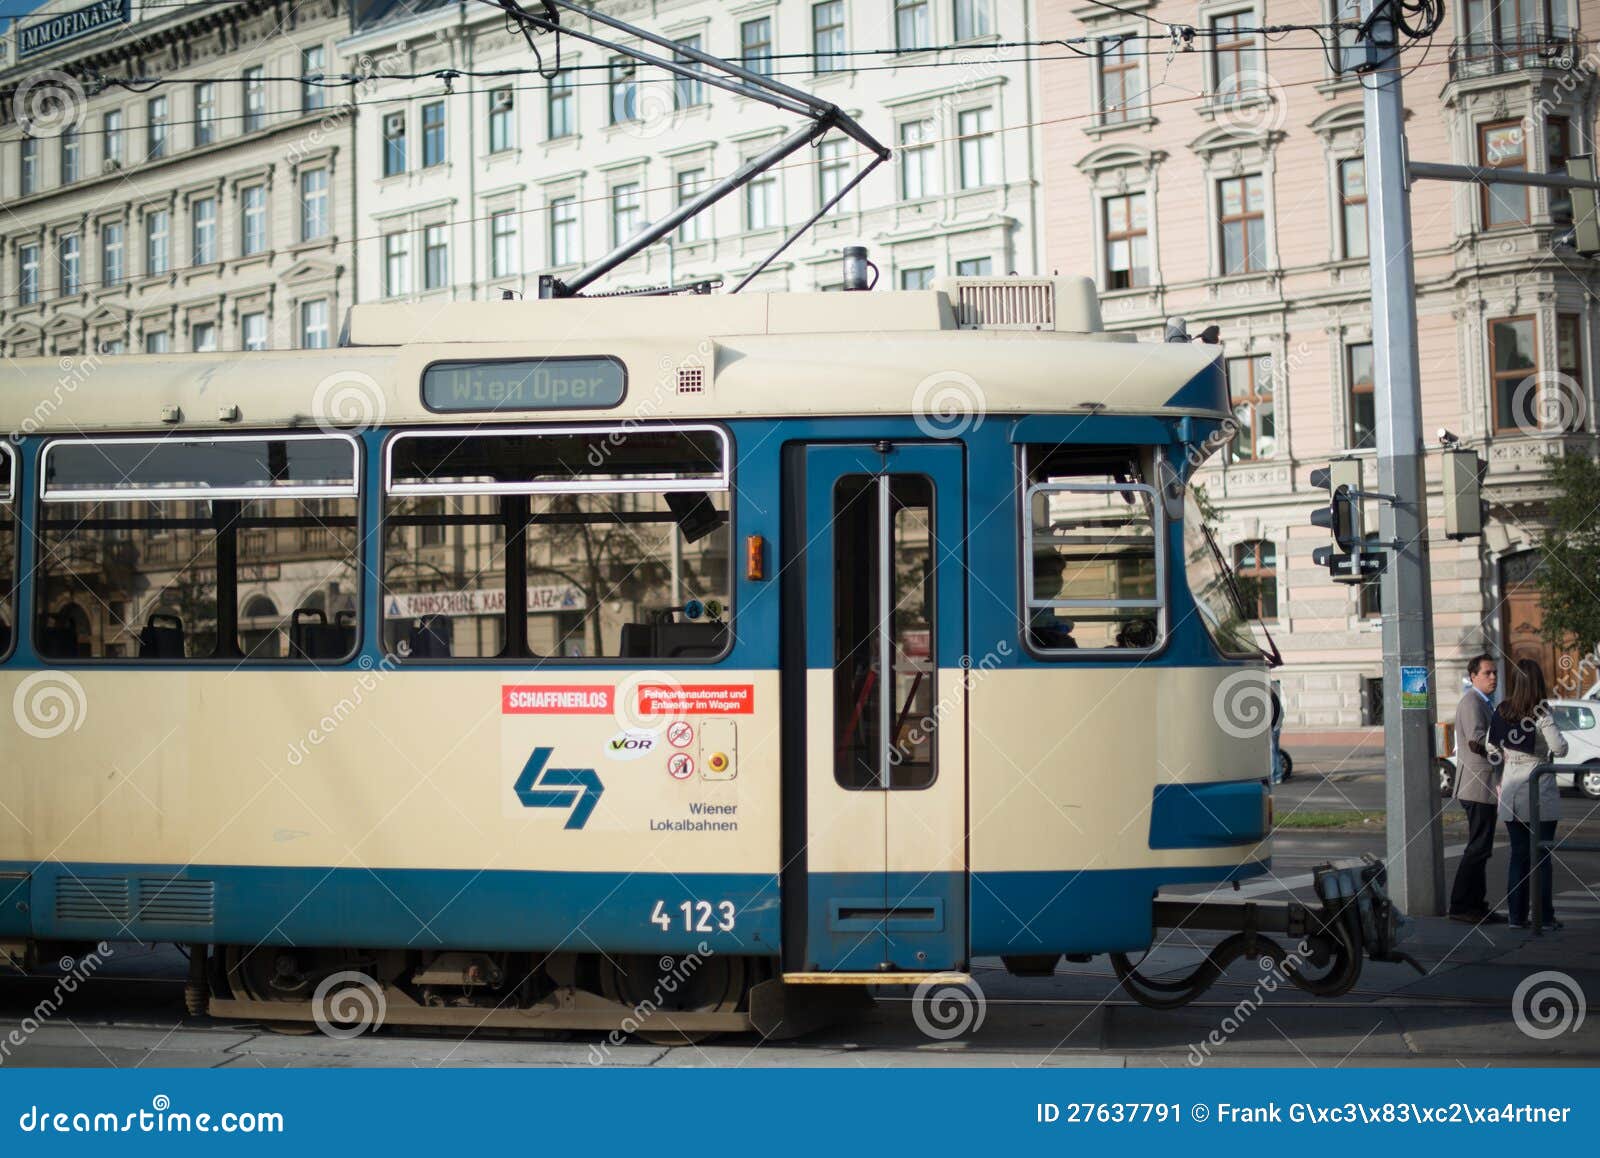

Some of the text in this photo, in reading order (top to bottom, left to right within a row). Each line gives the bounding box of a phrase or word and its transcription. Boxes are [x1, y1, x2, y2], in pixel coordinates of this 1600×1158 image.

[21, 0, 122, 50] IMMOFINANZ
[452, 368, 603, 402] Wien Oper
[482, 590, 554, 612] KARLATZ
[509, 690, 608, 709] SCHAFFNERLOS
[729, 689, 747, 698] und
[695, 700, 708, 709] im
[709, 700, 740, 711] Wagen
[612, 738, 652, 749] VOR
[689, 803, 738, 815] Wiener
[650, 819, 738, 831] Lokalbahnen
